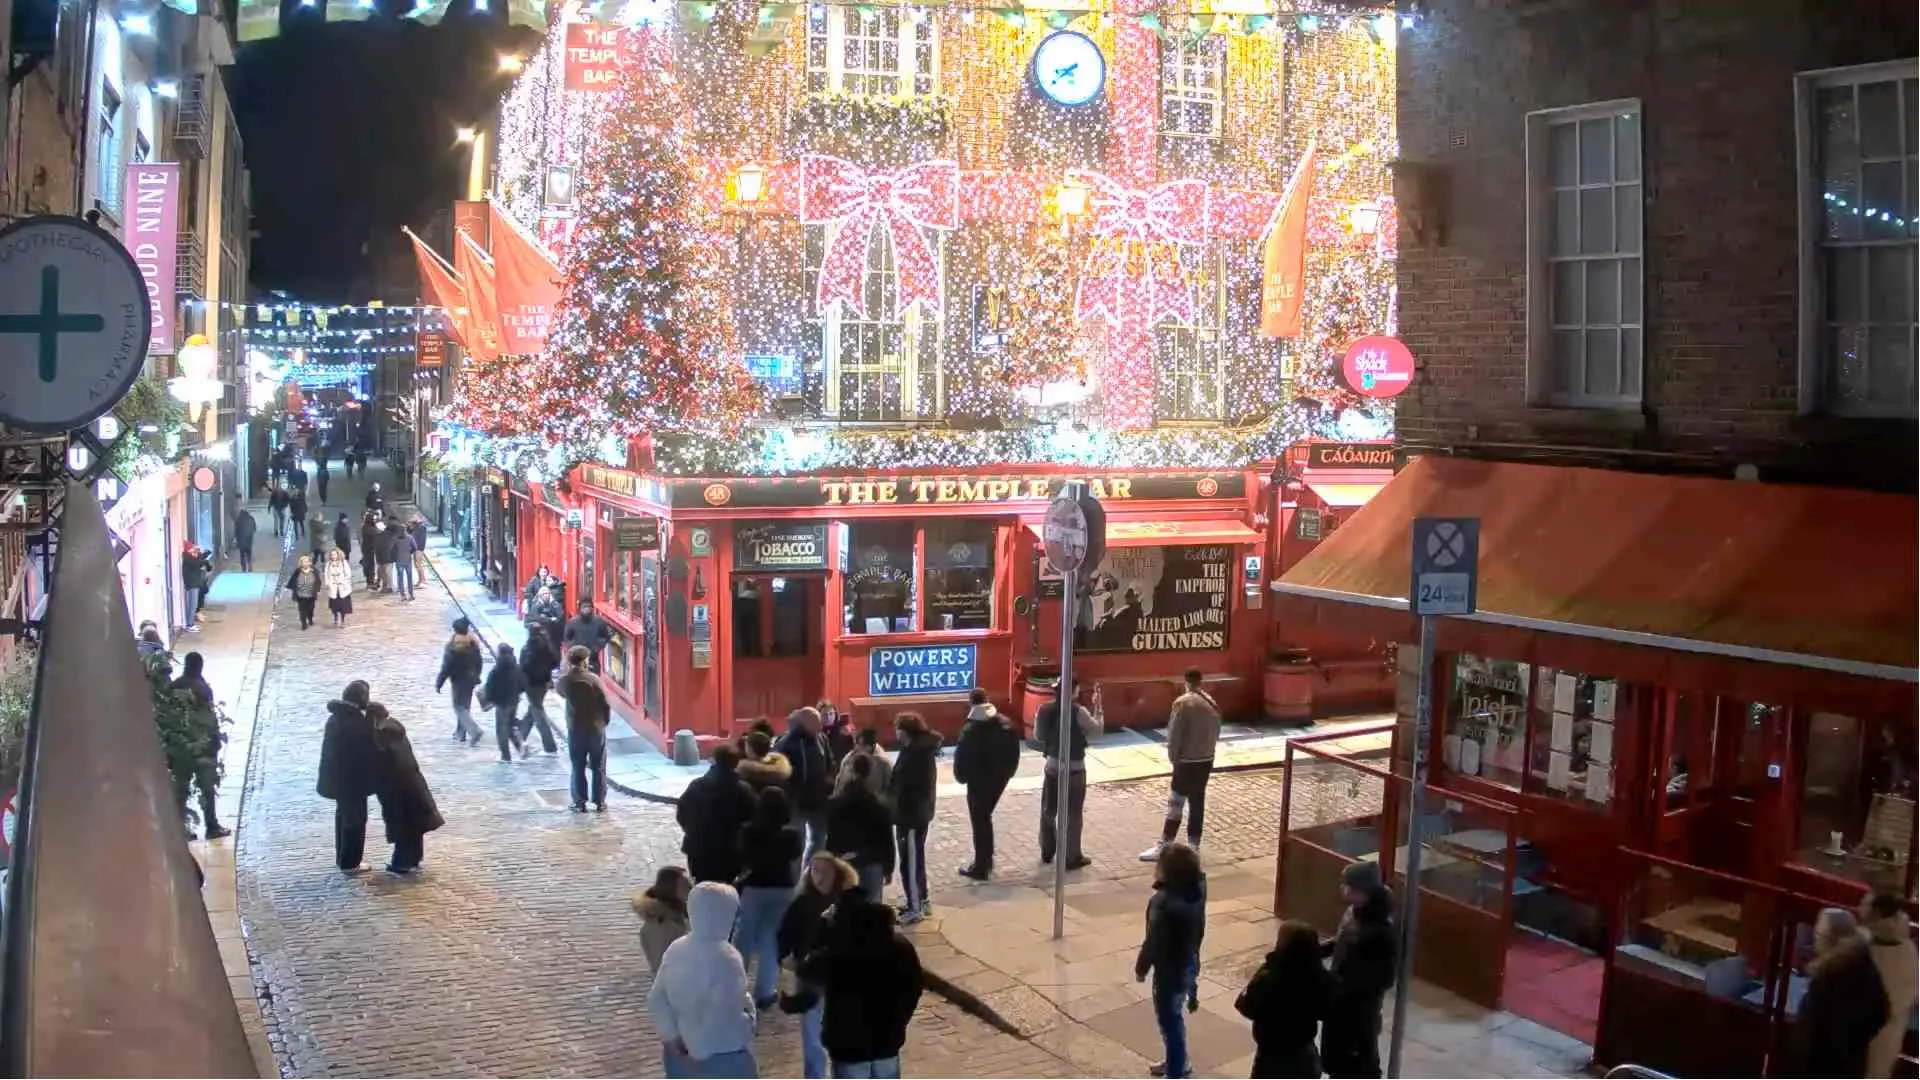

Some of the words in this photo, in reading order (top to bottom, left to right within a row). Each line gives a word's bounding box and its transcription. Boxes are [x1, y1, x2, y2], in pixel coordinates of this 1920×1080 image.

[583, 29, 618, 45] THE
[136, 171, 169, 233] NINE
[90, 302, 136, 401] PHARMACY
[822, 481, 898, 505] THE
[911, 478, 1049, 503] TEMPLE
[847, 566, 890, 588] TEMPLE
[1203, 563, 1226, 578] THE
[1175, 578, 1226, 593] EMPEROR
[1420, 585, 1443, 603] 24
[1211, 593, 1225, 608] OF
[1136, 617, 1181, 632] MALTED
[1183, 608, 1225, 629] LIQUORS
[1132, 631, 1224, 650] GUINNESS
[879, 647, 969, 668] POWER'S
[872, 671, 973, 691] WHISKEY
